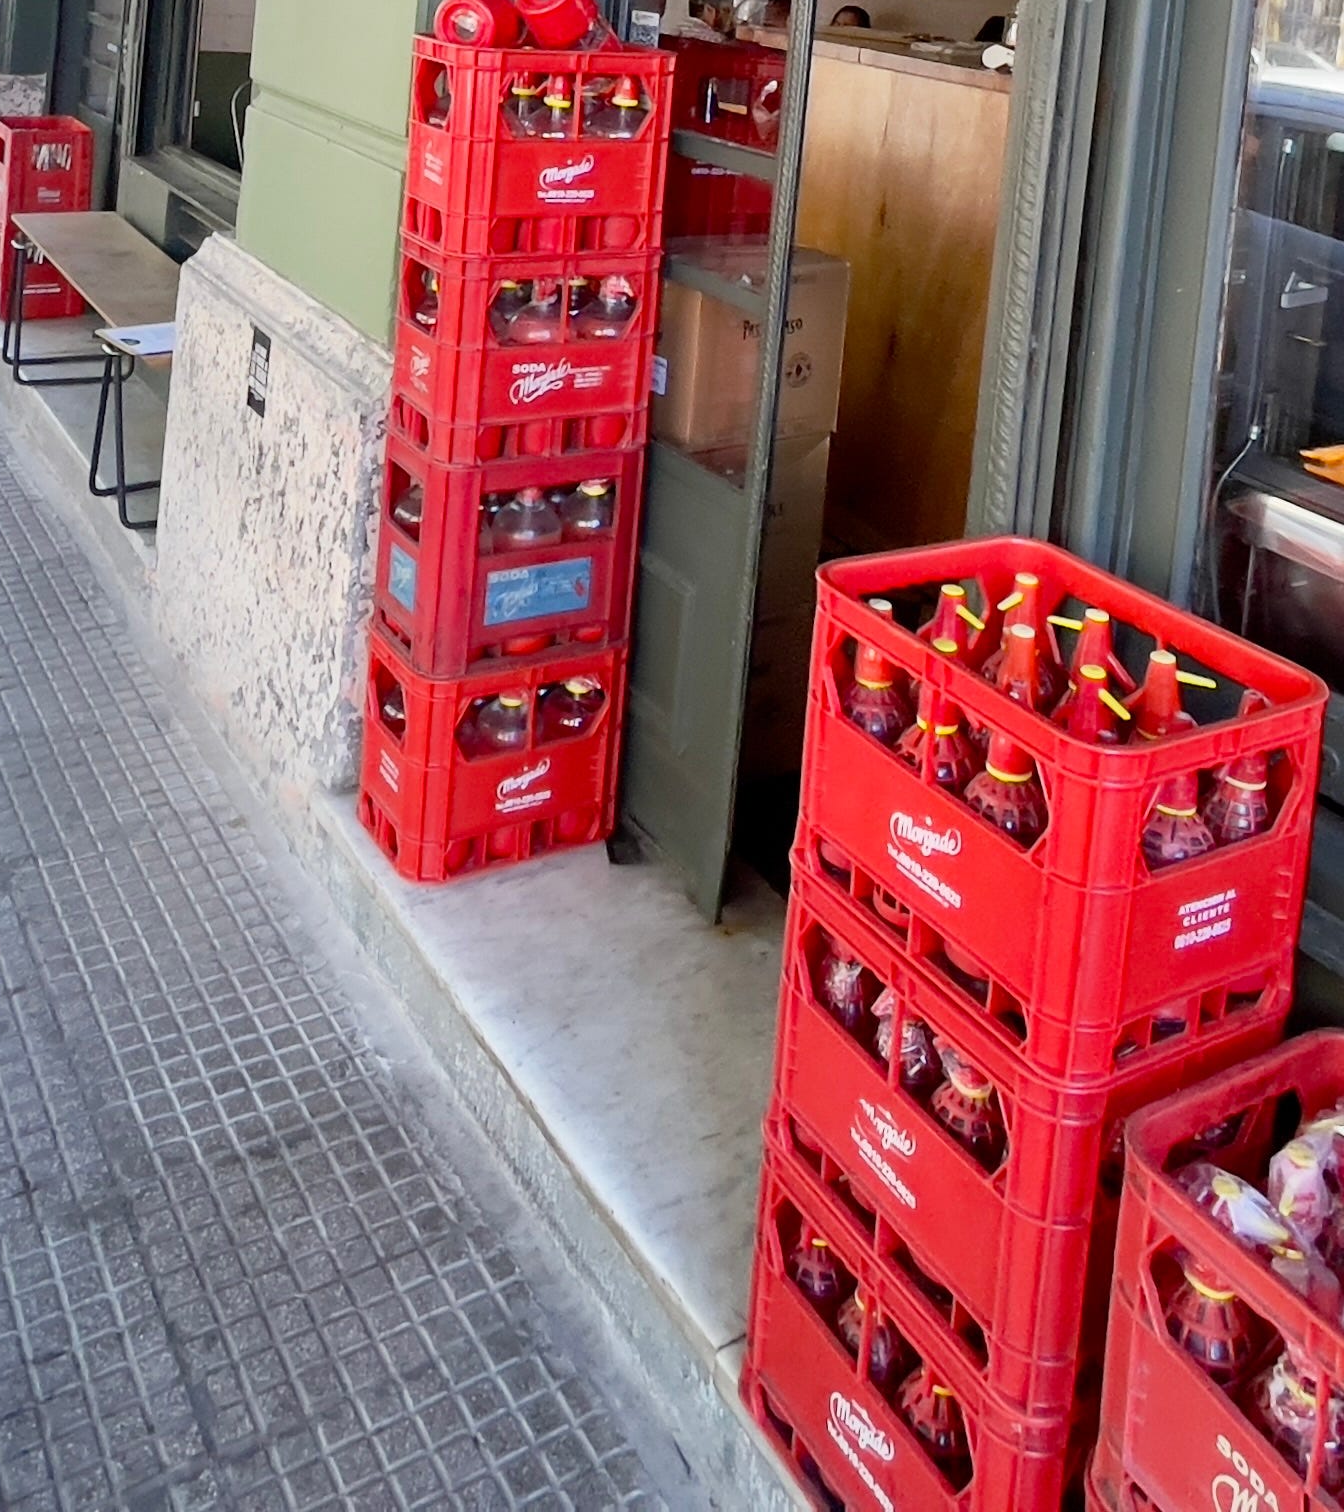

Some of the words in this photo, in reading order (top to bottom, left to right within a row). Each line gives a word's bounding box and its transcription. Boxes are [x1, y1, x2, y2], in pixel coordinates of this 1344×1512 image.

[512, 363, 546, 374] SODA
[889, 811, 962, 857] Morgade
[1225, 888, 1237, 901] AL
[1183, 902, 1231, 927] CLIENTE
[830, 1391, 895, 1461] Morgade
[1216, 1434, 1280, 1512] SODA
